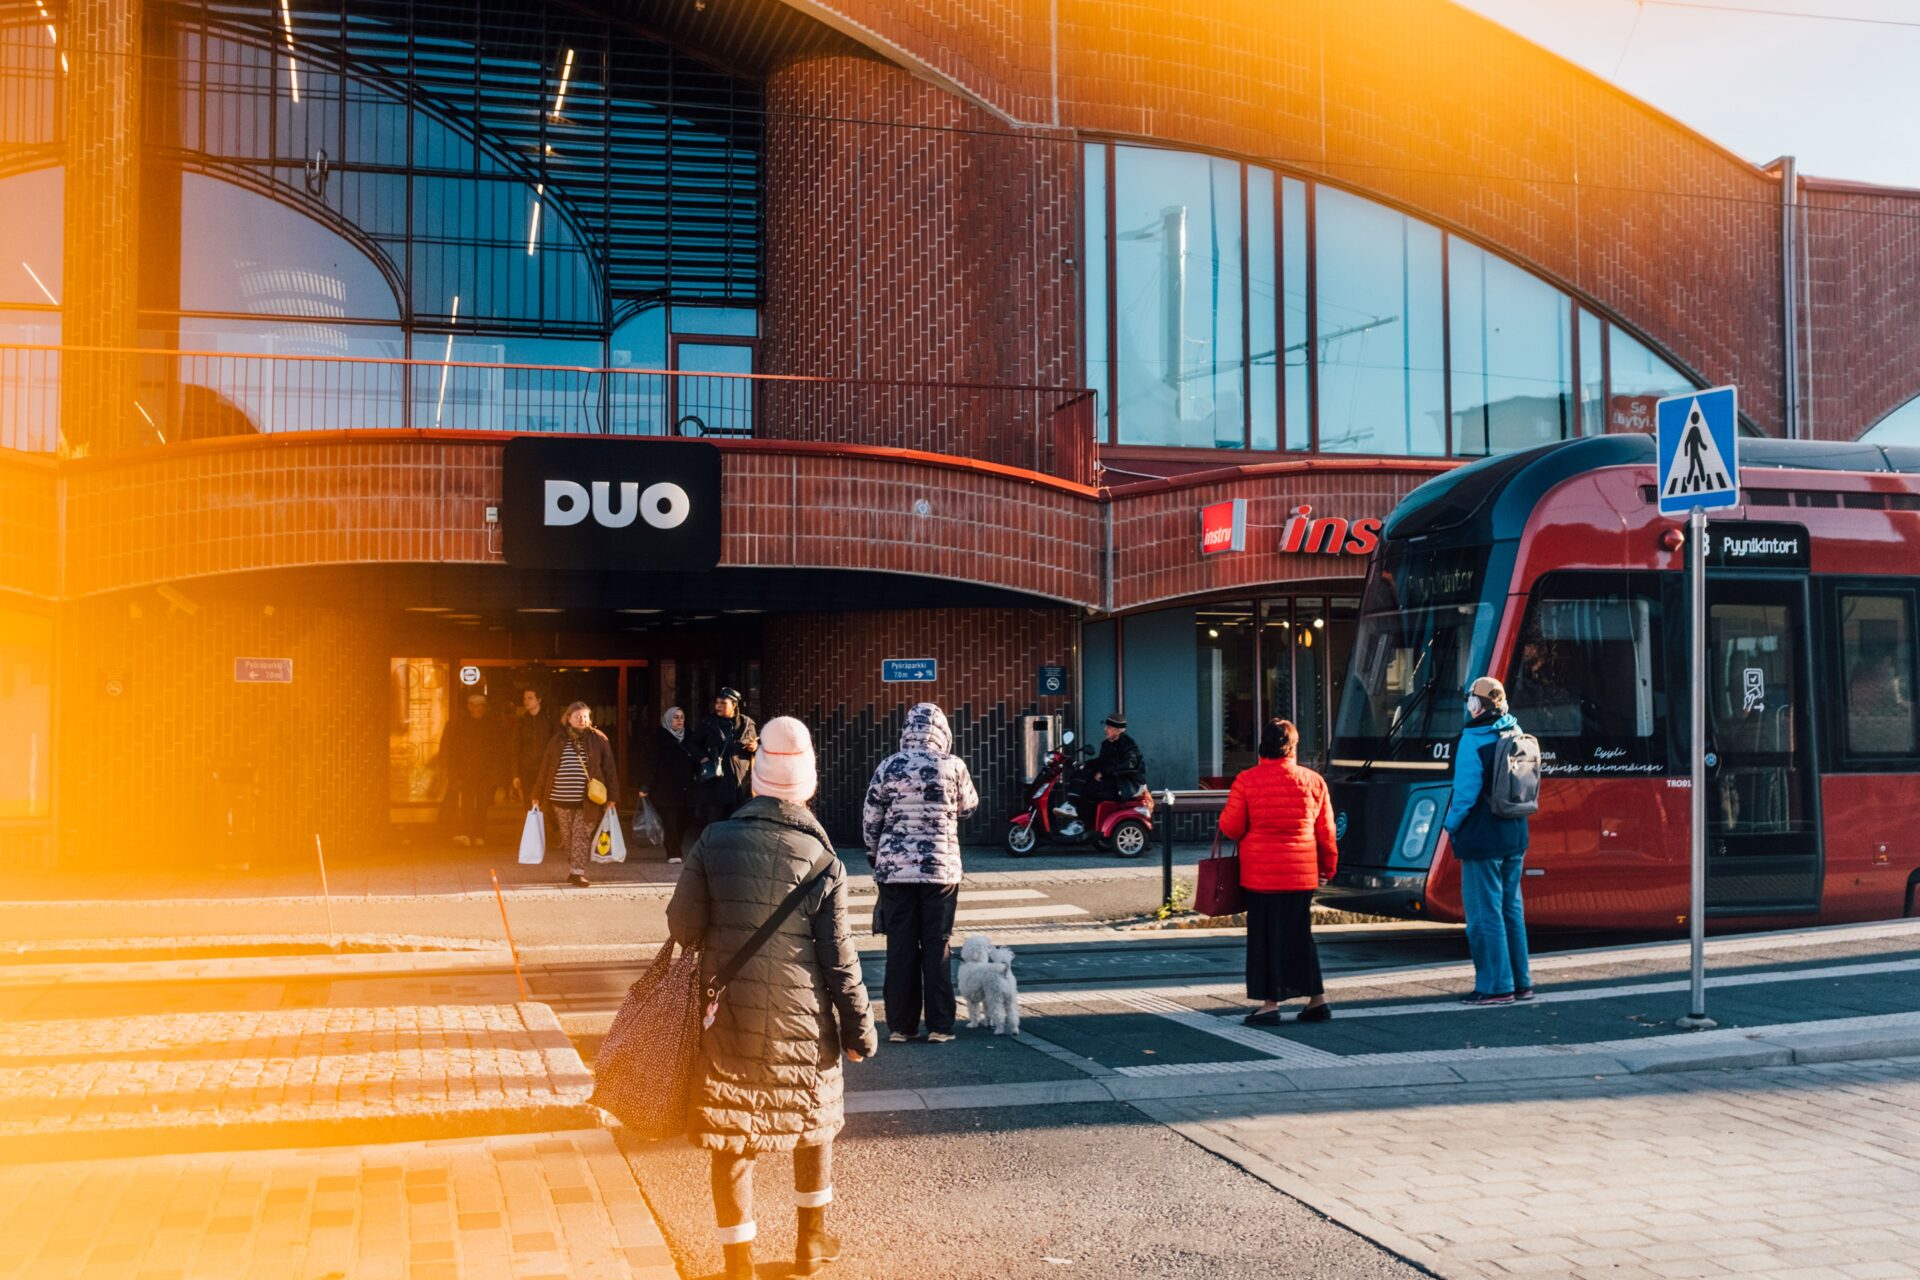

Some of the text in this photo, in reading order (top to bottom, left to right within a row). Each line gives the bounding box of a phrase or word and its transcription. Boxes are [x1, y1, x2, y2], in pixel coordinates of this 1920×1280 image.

[544, 479, 690, 529] DUO
[1204, 527, 1232, 546] instru
[1280, 504, 1383, 555] ins
[1723, 536, 1798, 556] Pyynikintori
[891, 661, 927, 670] Pyöräparkki
[1433, 742, 1451, 759] 01
[1540, 751, 1557, 760] ODA
